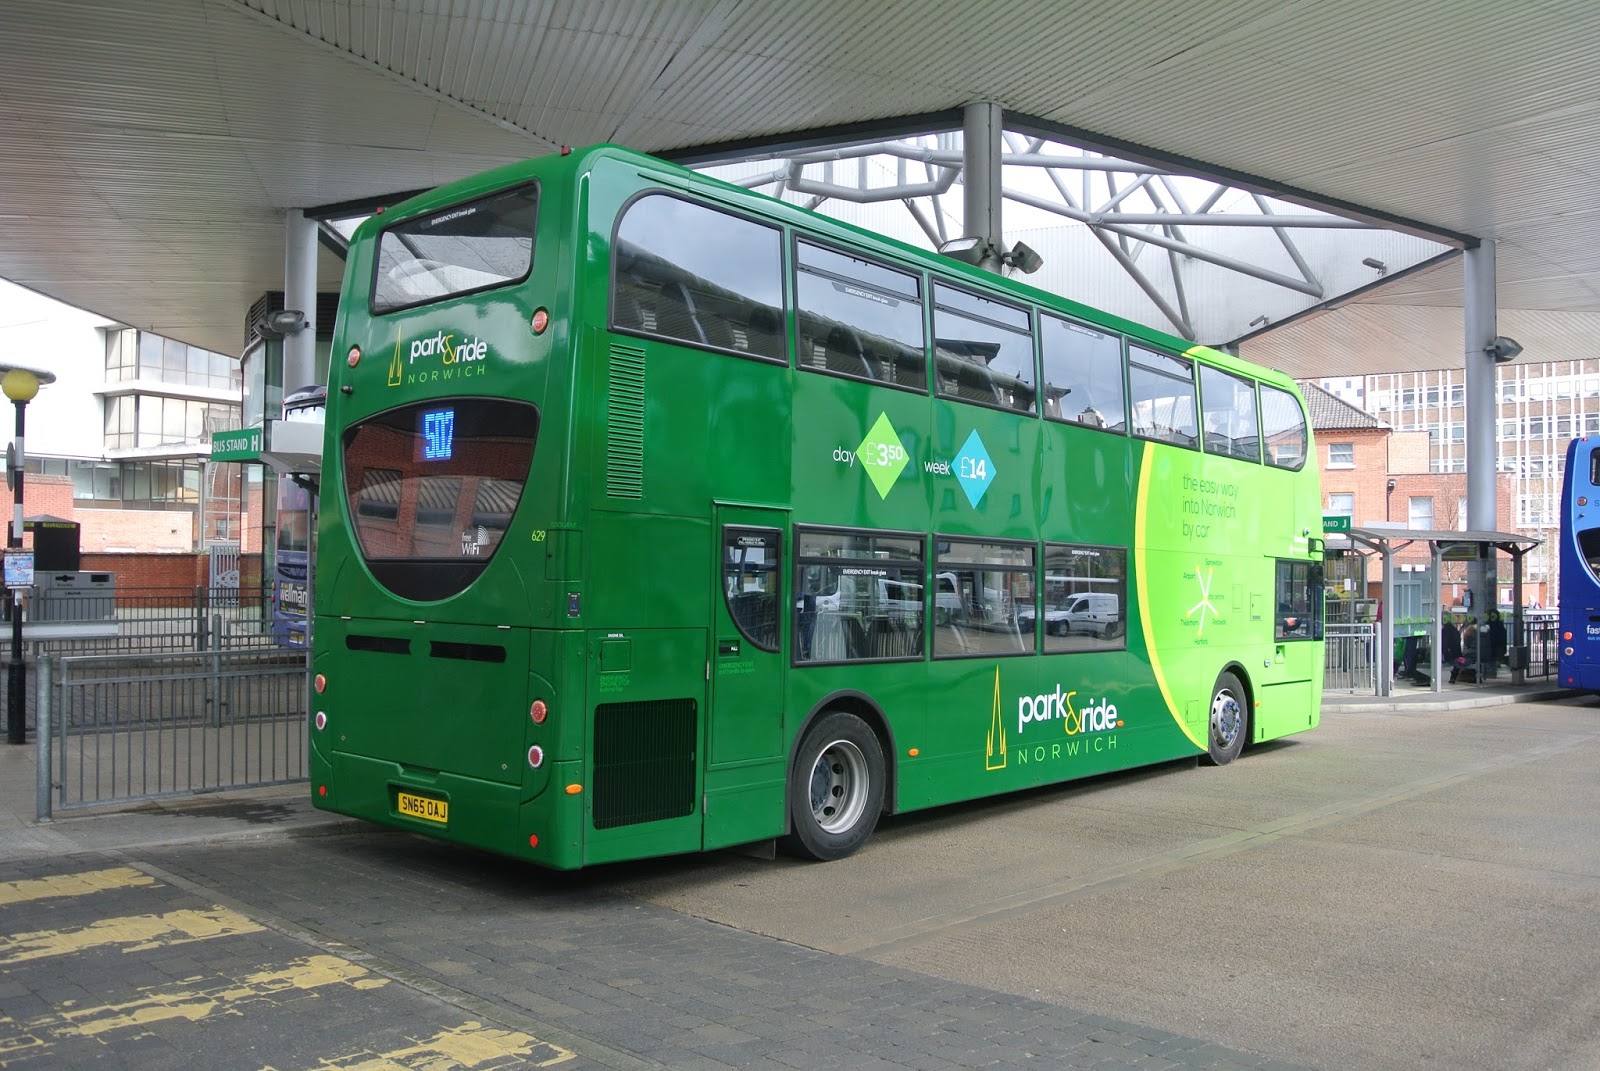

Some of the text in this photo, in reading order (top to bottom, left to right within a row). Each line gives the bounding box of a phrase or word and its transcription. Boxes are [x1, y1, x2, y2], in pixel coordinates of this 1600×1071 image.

[407, 364, 485, 384] NORWICH
[213, 434, 259, 452] BUS STAND H
[425, 411, 454, 459] 507
[832, 445, 856, 467] day
[924, 456, 987, 480] week £14
[1182, 472, 1239, 501] the easy way
[1182, 495, 1236, 519] into Norwich
[1182, 519, 1210, 542] by car
[1323, 518, 1348, 529] AND J
[461, 531, 472, 542] free
[531, 529, 546, 542] 629
[461, 542, 480, 556] WiFi
[1018, 734, 1118, 765] NORWICH
[402, 795, 447, 818] SN65 OAJ
